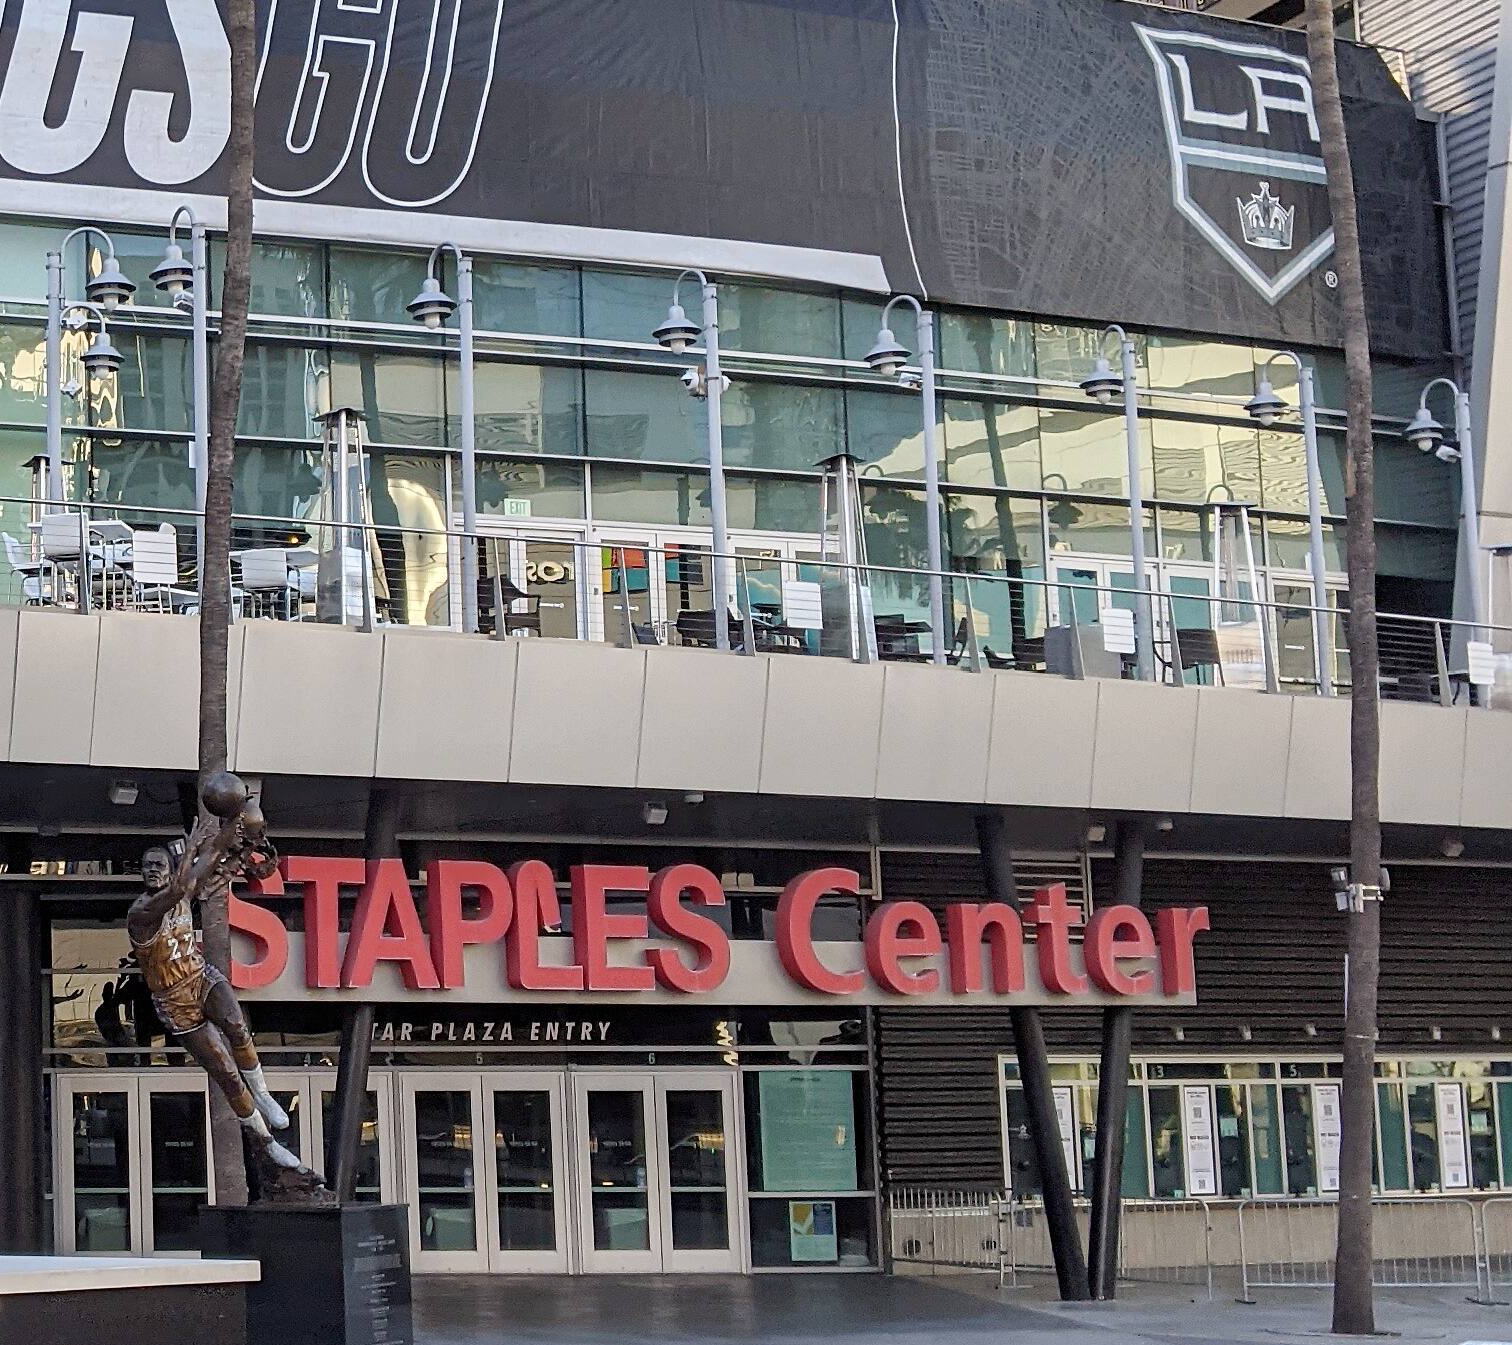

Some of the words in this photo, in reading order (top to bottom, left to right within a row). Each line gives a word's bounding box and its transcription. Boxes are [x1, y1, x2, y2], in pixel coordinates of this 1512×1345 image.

[1165, 52, 1320, 142] LA
[509, 501, 527, 515] EXIT
[228, 853, 730, 994] STAPLES
[775, 867, 1211, 997] Center
[431, 1021, 514, 1043] PLAZA
[529, 1021, 613, 1043] ENTRY
